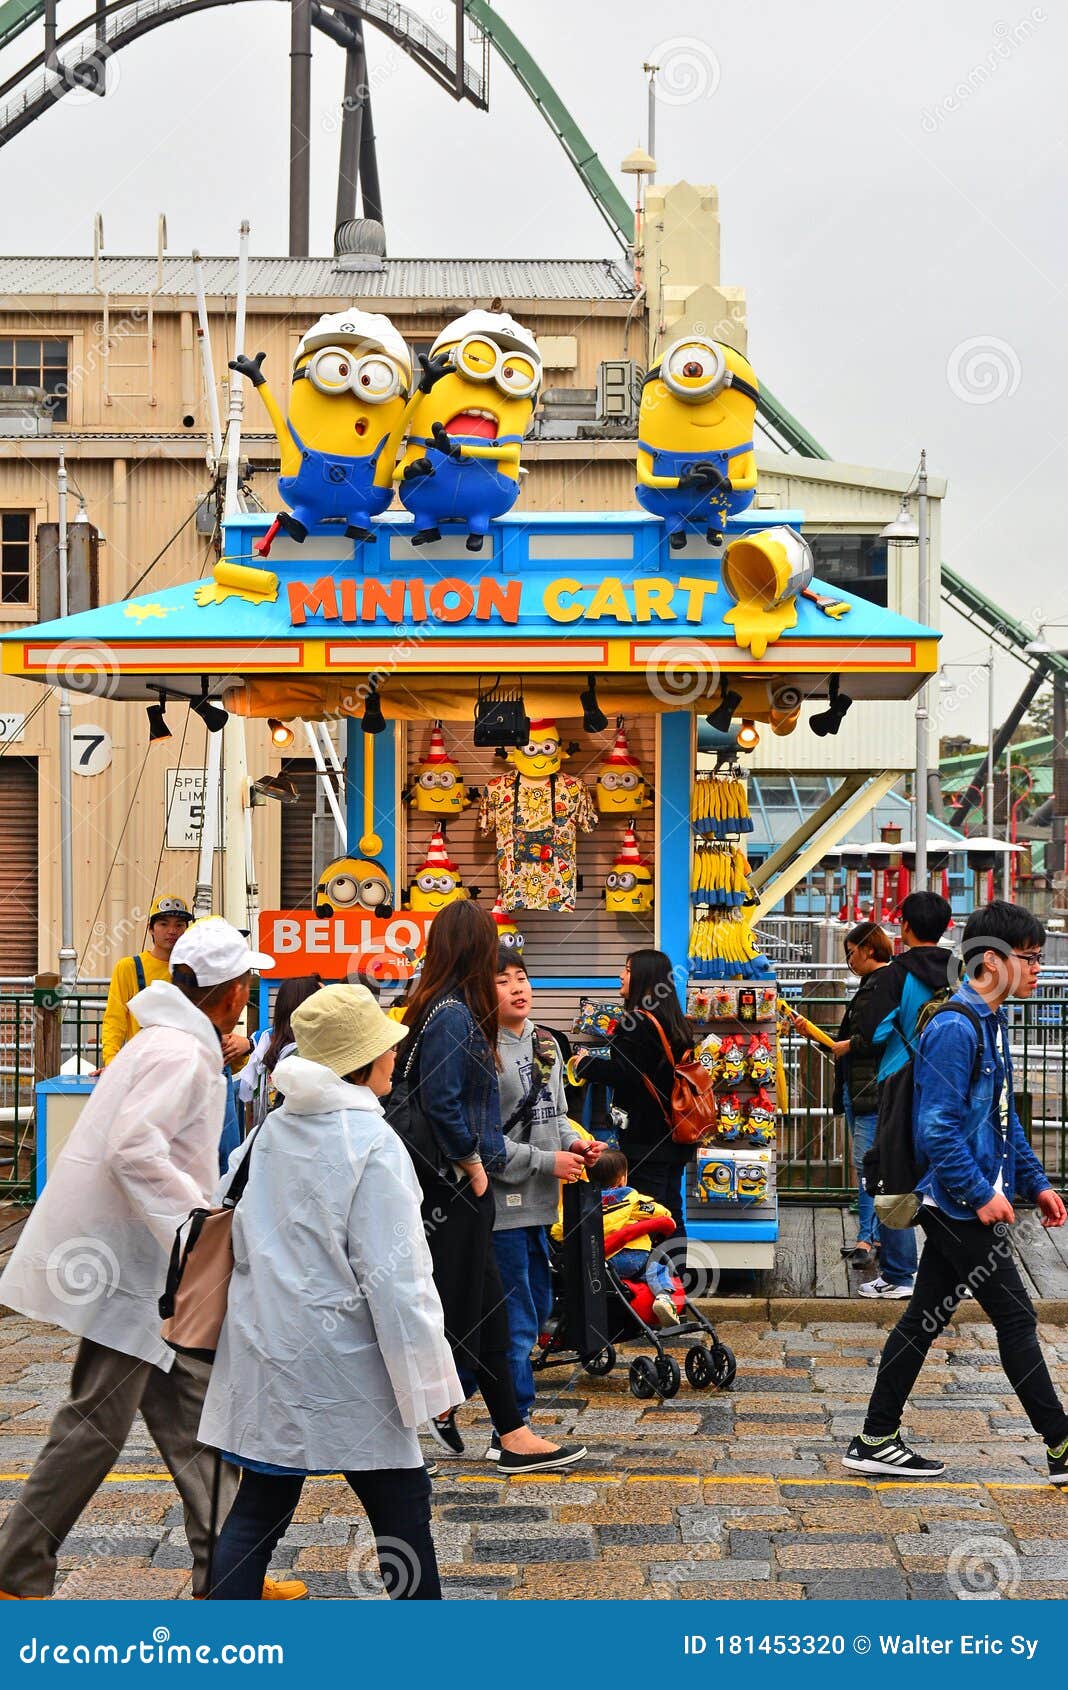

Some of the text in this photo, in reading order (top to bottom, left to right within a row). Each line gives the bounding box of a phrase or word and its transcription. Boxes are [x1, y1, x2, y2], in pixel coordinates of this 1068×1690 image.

[287, 576, 719, 625] MINION CART
[73, 735, 104, 765] 7
[175, 777, 209, 788] SPEE
[179, 791, 207, 802] LIMI
[189, 805, 206, 830] 5
[184, 832, 203, 841] MP
